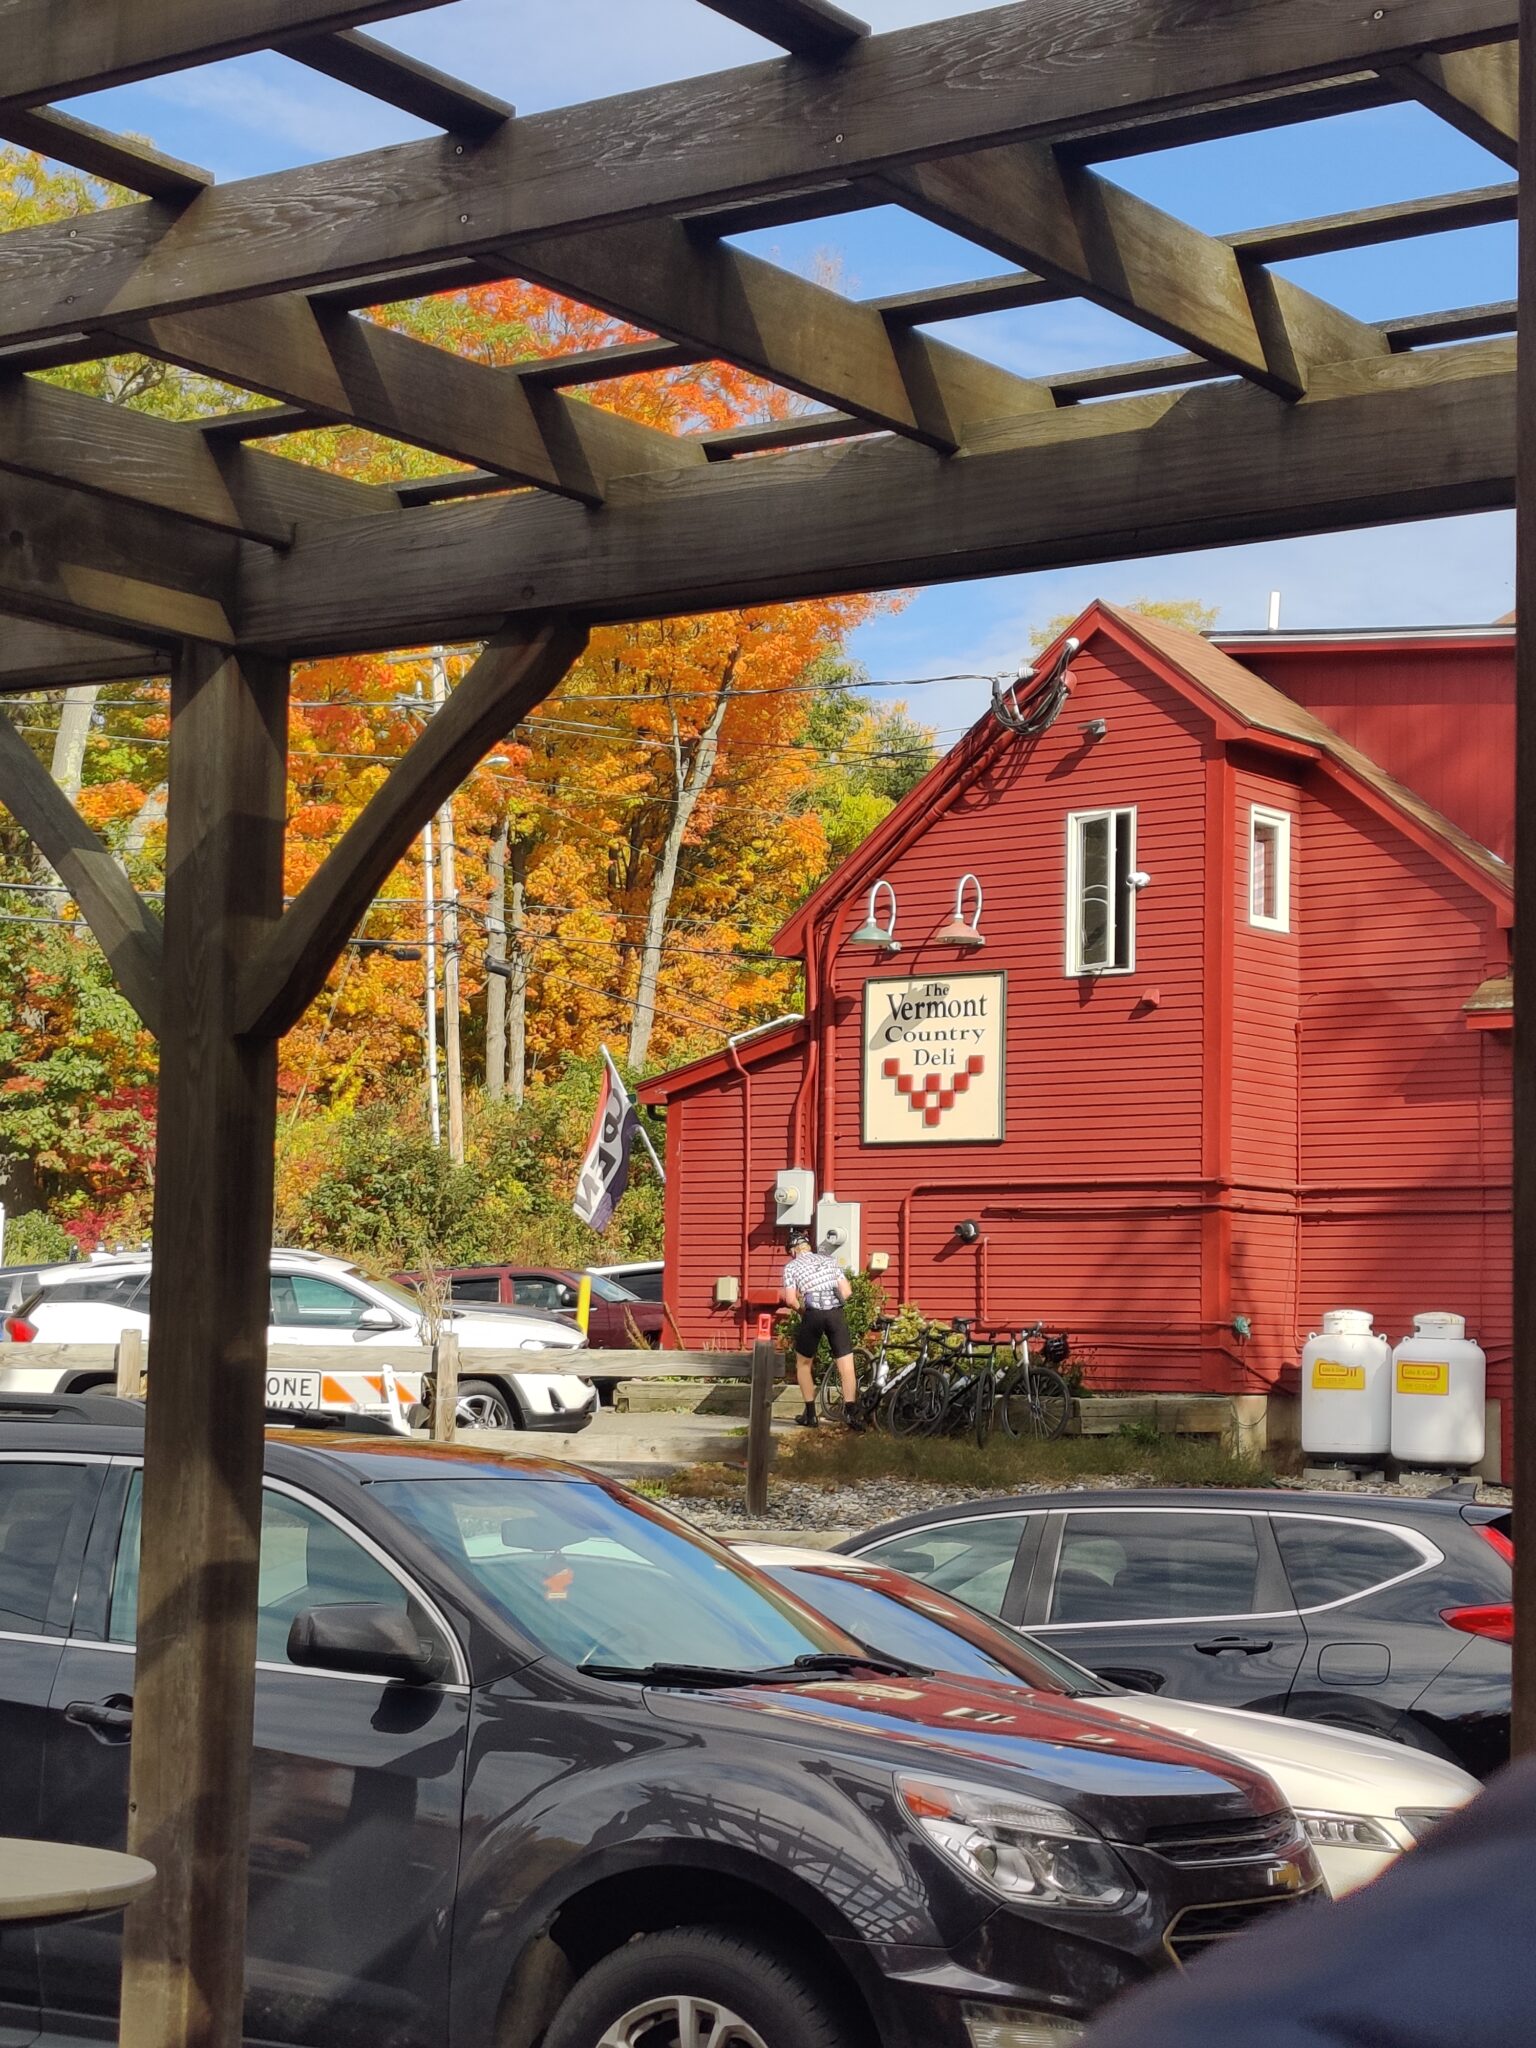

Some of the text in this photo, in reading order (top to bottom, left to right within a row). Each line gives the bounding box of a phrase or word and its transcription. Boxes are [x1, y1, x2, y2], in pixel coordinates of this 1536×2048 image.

[923, 983, 950, 997] The
[886, 993, 988, 1021] Vermont
[884, 1025, 986, 1044] Country
[913, 1048, 956, 1066] Deli
[267, 1377, 312, 1397] ONE
